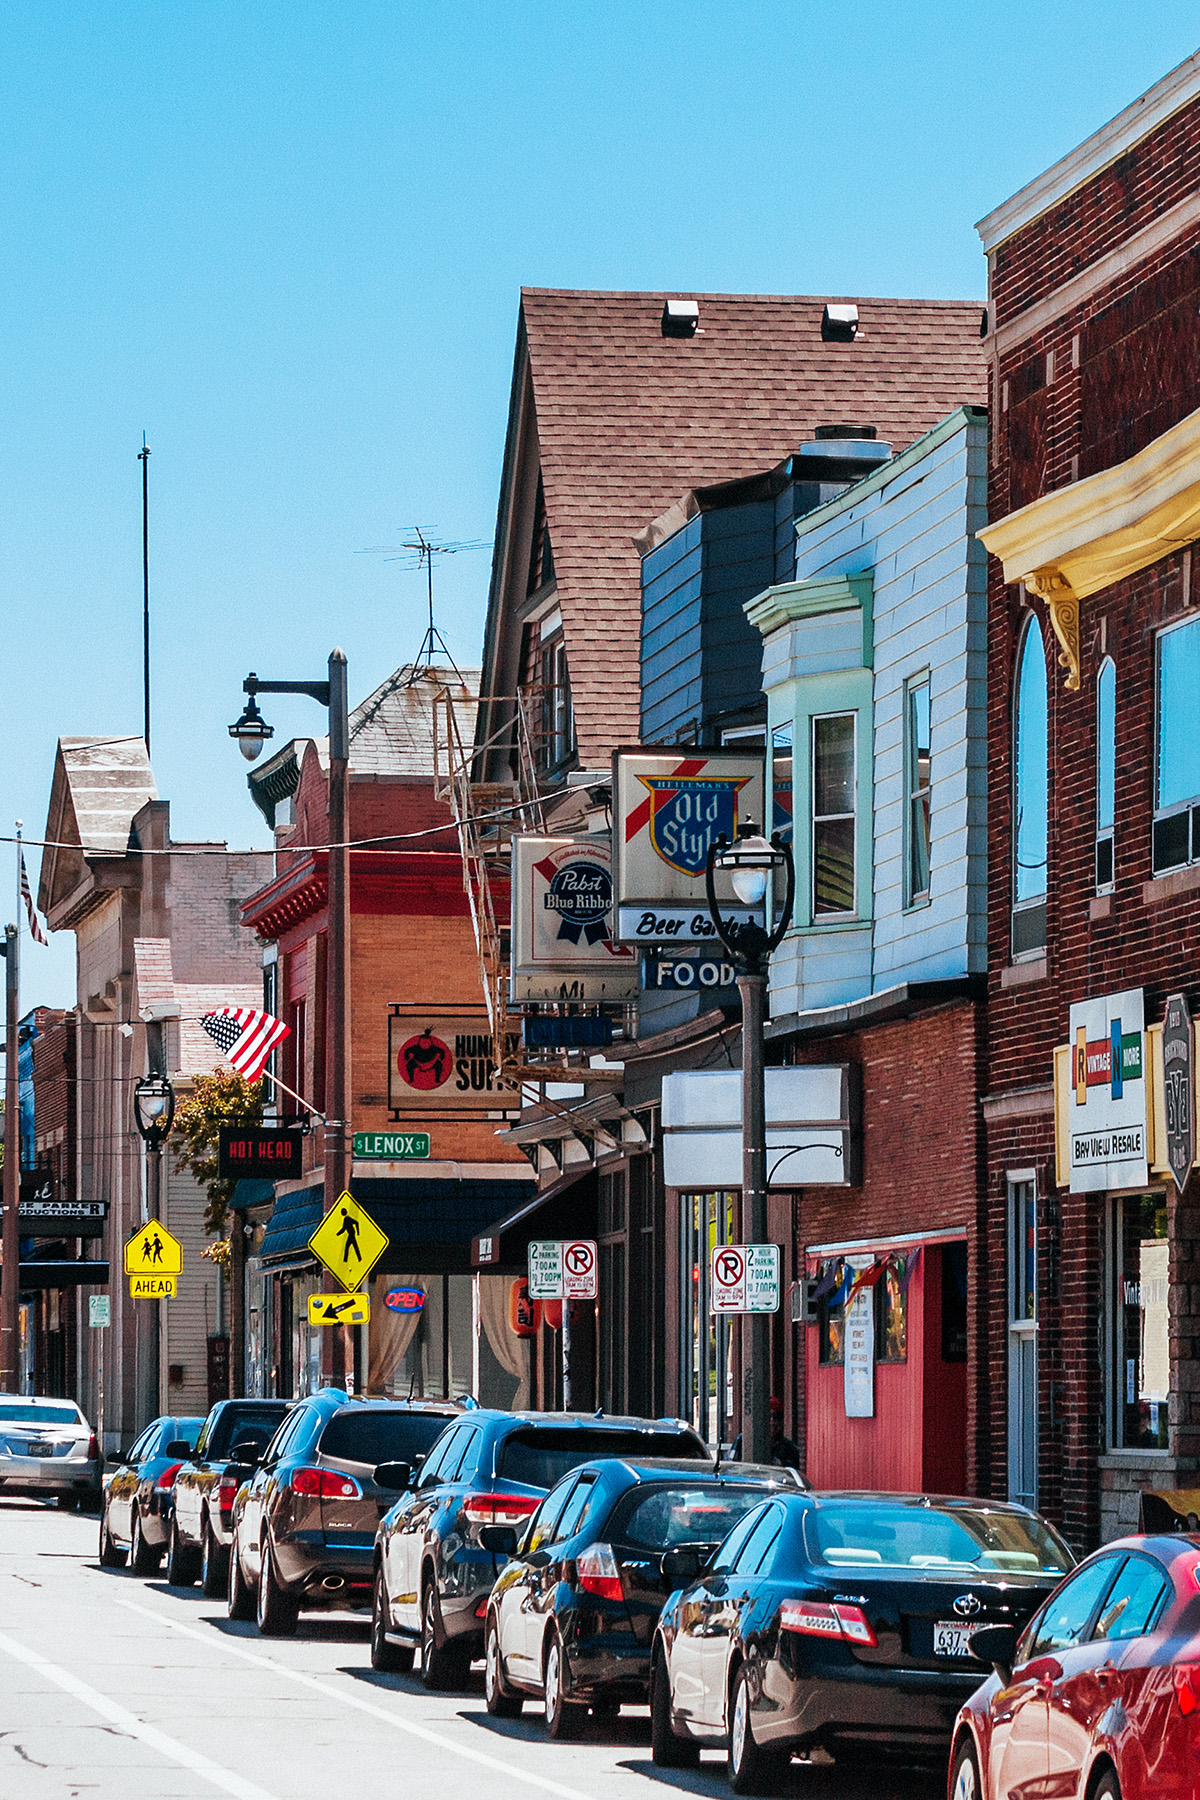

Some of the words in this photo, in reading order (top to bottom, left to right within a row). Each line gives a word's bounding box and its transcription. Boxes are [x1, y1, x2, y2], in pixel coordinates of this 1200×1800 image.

[675, 793, 718, 823] Old
[662, 820, 724, 865] Styl
[559, 870, 603, 890] Pabst
[546, 894, 573, 908] Blue
[576, 894, 611, 908] Ribbo
[636, 912, 685, 935] Beer
[657, 962, 735, 986] FOOD
[1078, 1048, 1085, 1083] R
[1087, 1052, 1111, 1073] VINTAGE
[1113, 1045, 1121, 1082] N
[1123, 1046, 1140, 1067] MORE
[229, 1140, 253, 1158] HOT
[258, 1140, 292, 1159] HEAD
[357, 1140, 363, 1149] S
[364, 1136, 414, 1154] LENOX
[416, 1141, 425, 1150] ST
[531, 1244, 538, 1259] 2
[747, 1249, 754, 1266] 2
[134, 1280, 173, 1293] AHEAD
[385, 1292, 426, 1308] OPEN
